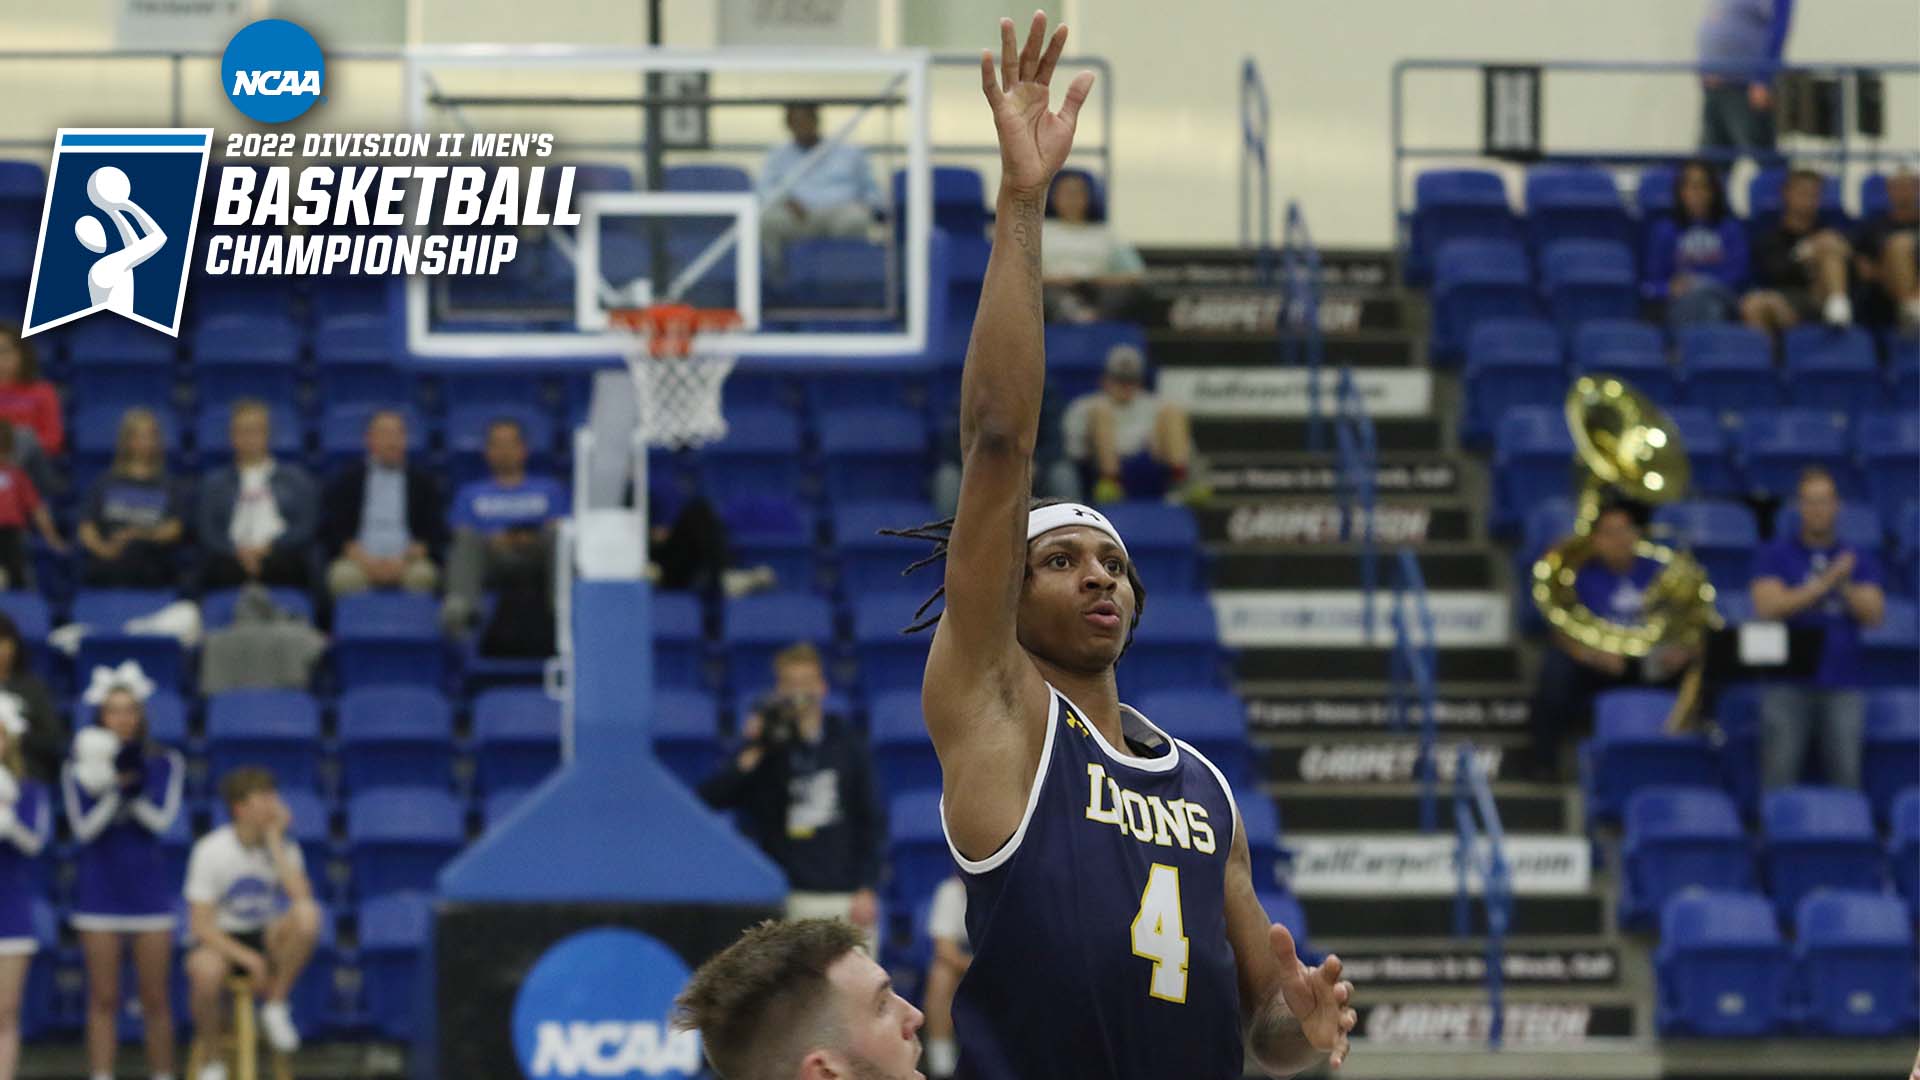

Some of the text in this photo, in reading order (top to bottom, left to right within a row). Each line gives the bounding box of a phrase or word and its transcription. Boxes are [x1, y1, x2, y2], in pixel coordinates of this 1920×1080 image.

[1086, 763, 1217, 855] LIONS
[1130, 863, 1190, 1005] 4
[530, 1020, 700, 1077] NCAA
